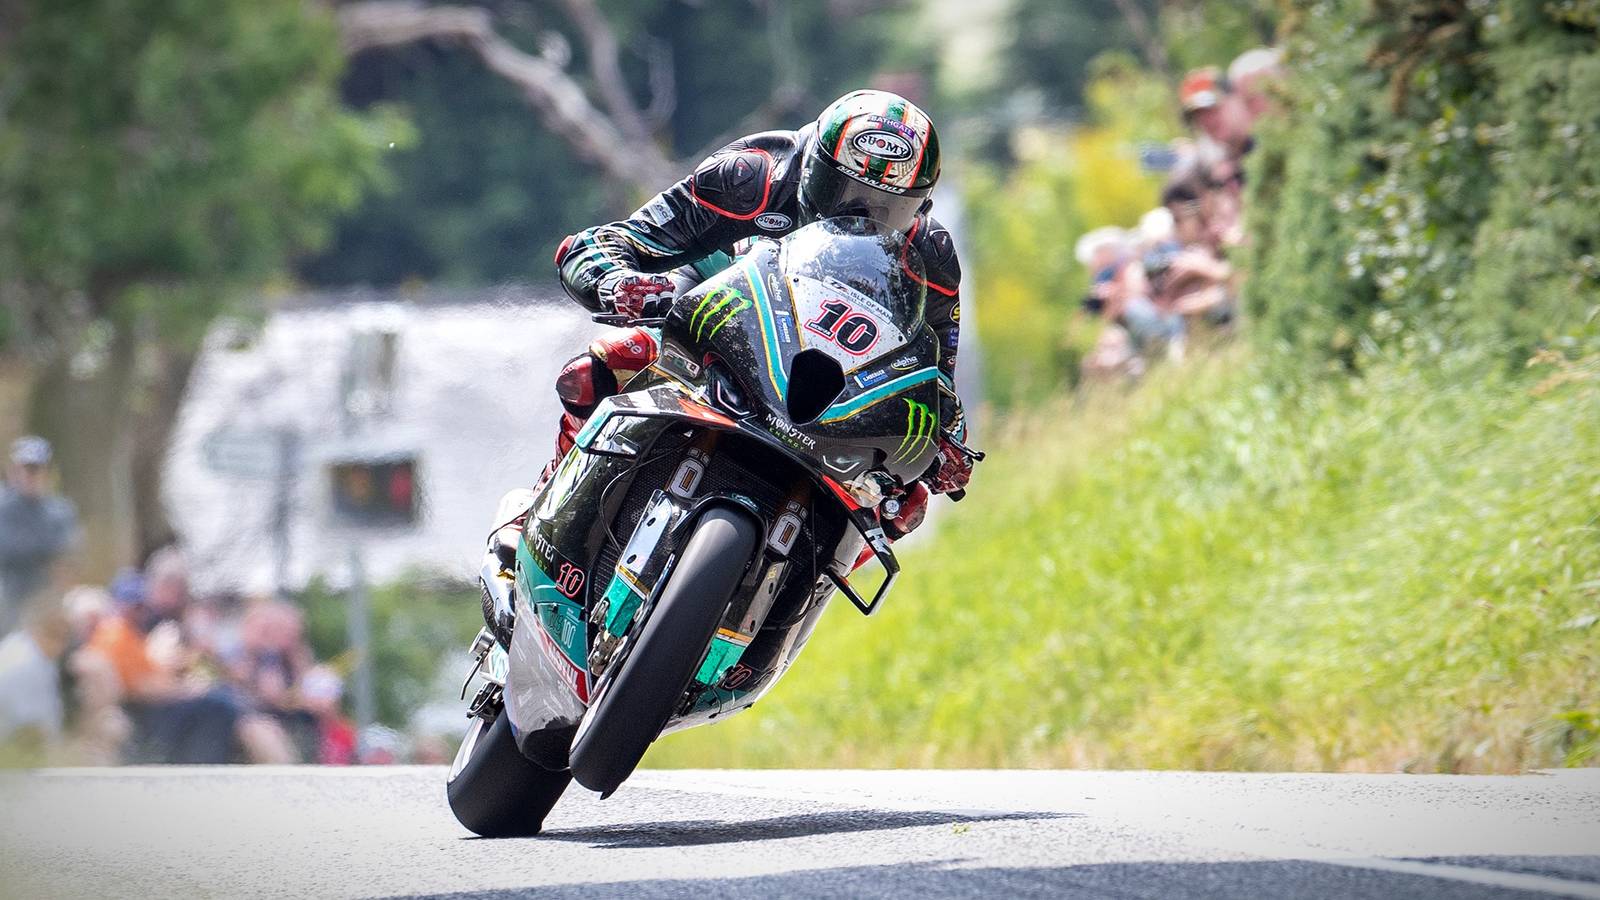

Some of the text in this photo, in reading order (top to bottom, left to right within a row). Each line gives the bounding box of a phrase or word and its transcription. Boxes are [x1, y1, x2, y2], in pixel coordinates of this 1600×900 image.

[859, 134, 908, 157] SUOMY
[757, 216, 788, 229] SUOMY
[849, 290, 866, 303] ISLE
[864, 299, 876, 309] OF
[875, 306, 893, 320] MAN
[804, 299, 880, 356] 10
[893, 355, 919, 368] alpha
[765, 413, 816, 450] MONSTER
[769, 427, 804, 450] ENERGY
[556, 563, 585, 598] 10
